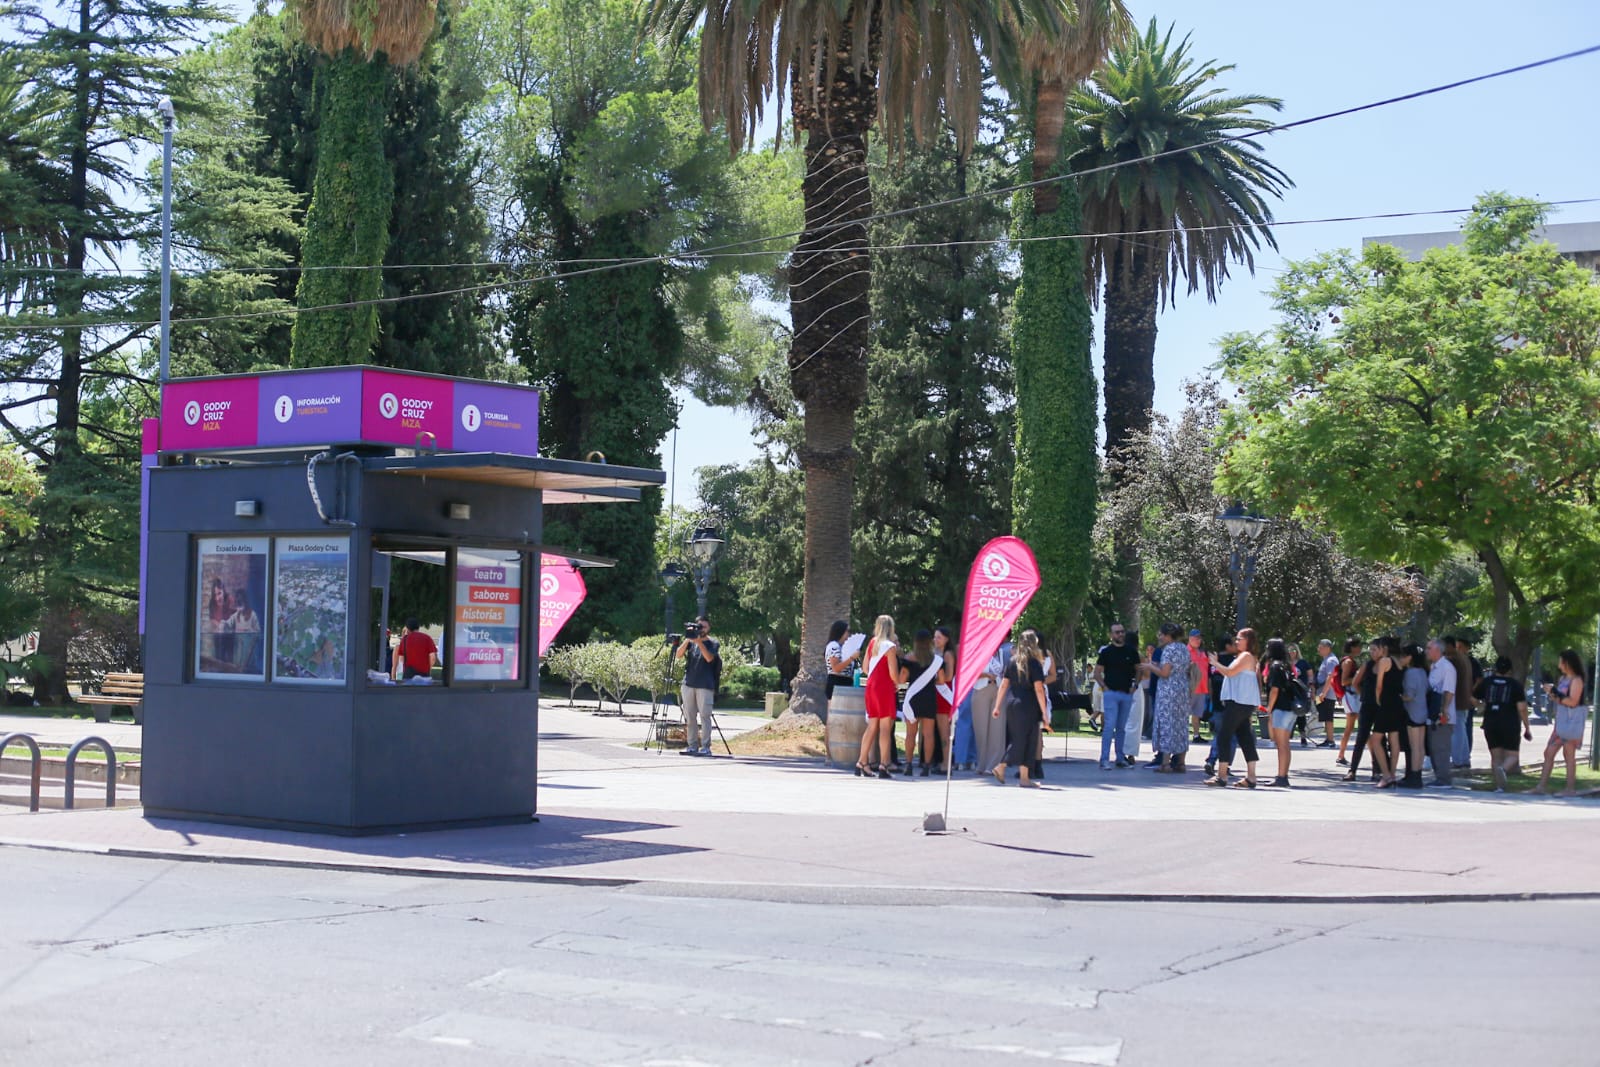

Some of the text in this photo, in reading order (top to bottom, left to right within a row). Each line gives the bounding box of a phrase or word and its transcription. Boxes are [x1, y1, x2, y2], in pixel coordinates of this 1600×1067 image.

[203, 401, 232, 412] GODOY
[402, 398, 433, 410] GODOY
[203, 411, 224, 422] CRUZ
[401, 408, 425, 419] CRUZ
[202, 422, 221, 432] MZA
[401, 418, 422, 429] MZA
[474, 568, 503, 581] teatro
[473, 589, 510, 601] sabores
[980, 586, 1027, 600] GODOY
[540, 600, 572, 611] ODOY
[978, 597, 1013, 611] CRUZ
[462, 608, 503, 621] historias
[540, 609, 561, 619] RUZ
[470, 630, 490, 640] arte
[469, 650, 502, 661] música
